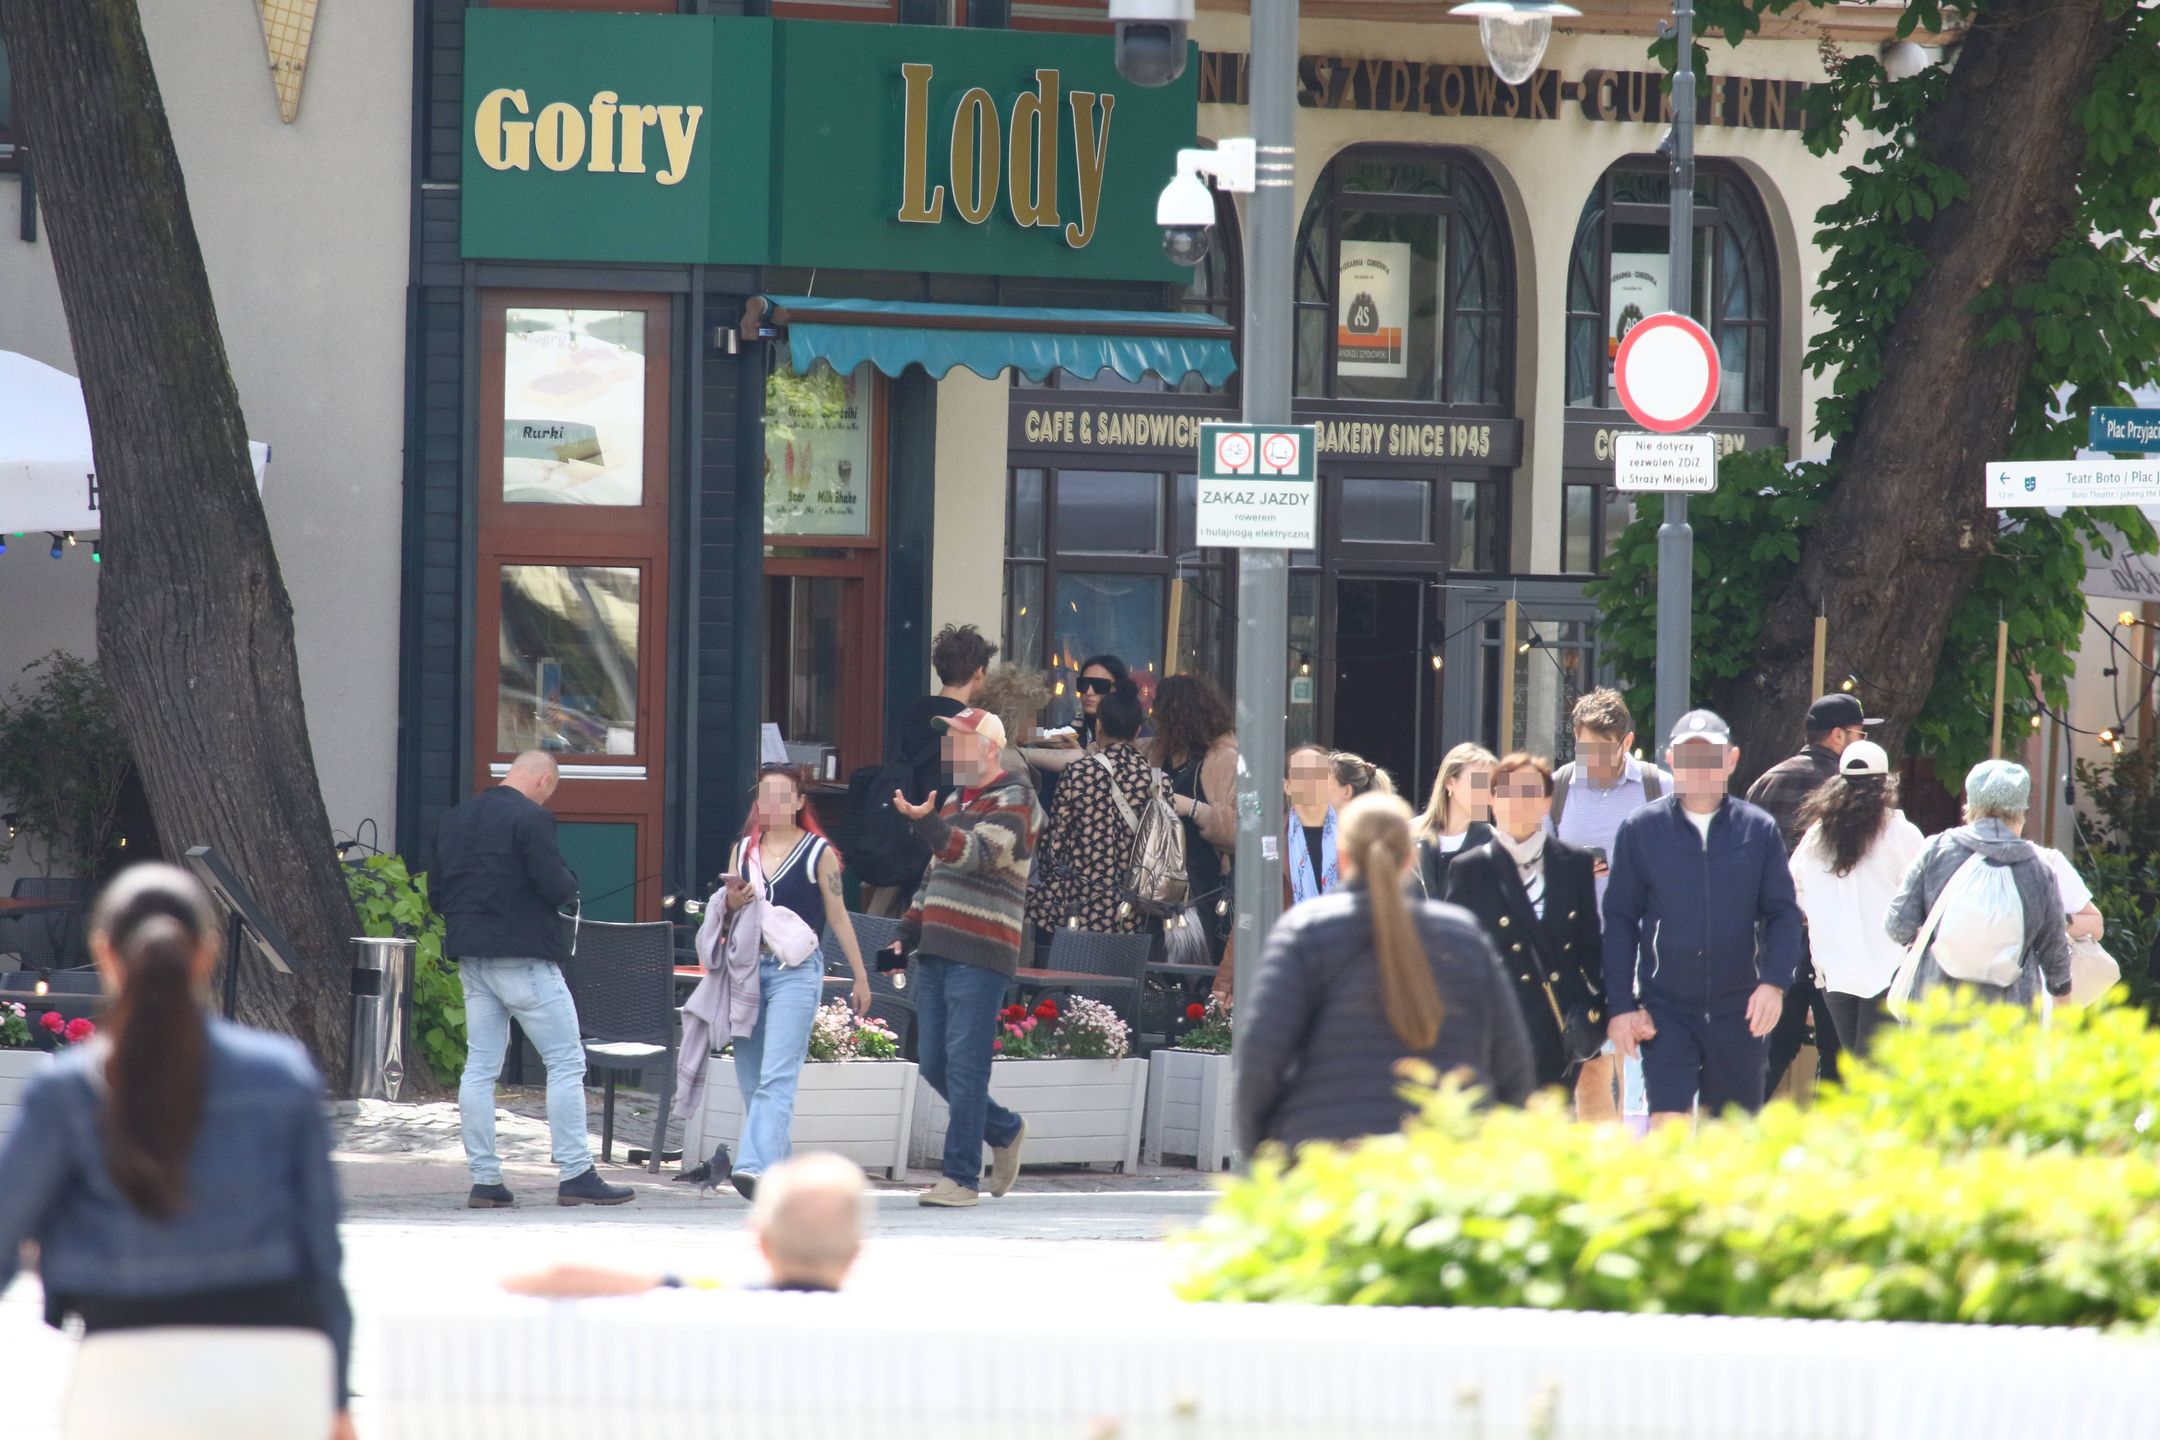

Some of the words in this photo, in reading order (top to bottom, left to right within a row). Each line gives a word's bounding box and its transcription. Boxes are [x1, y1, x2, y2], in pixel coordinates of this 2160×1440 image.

[1314, 54, 1562, 120] SZYDŁOWSKI
[474, 88, 703, 185] Gofry
[898, 63, 1115, 248] Lody
[1354, 305, 1369, 327] AS
[523, 426, 564, 439] Rurki
[1025, 410, 1074, 443] CAFE
[1079, 411, 1092, 444] &
[1097, 411, 1223, 448] SANDWICH
[2107, 419, 2126, 438] Plac
[1315, 420, 1384, 454] BAKERY
[1388, 423, 1444, 456] SINCE
[1450, 424, 1490, 457] 1945
[1635, 441, 1652, 451] Nie
[1656, 441, 1694, 454] dotyczy
[1678, 457, 1700, 468] ZDiZ
[1629, 475, 1660, 486] Straży
[1663, 474, 1708, 487] Miejskiej
[2066, 472, 2093, 484] Teatr
[2096, 472, 2121, 484] Boto
[2131, 470, 2153, 482] Plac
[817, 491, 833, 504] Milk
[834, 491, 857, 505] Shake
[1202, 491, 1255, 505] ZAKAZ
[1259, 493, 1310, 506] JAZDY
[2090, 490, 2114, 498] Theatre
[2120, 490, 2144, 500] Johnny
[2146, 489, 2157, 497] the
[1234, 513, 1276, 521] rowerem
[1205, 528, 1253, 539] hulajnogą
[1255, 529, 1310, 540] elektryczną
